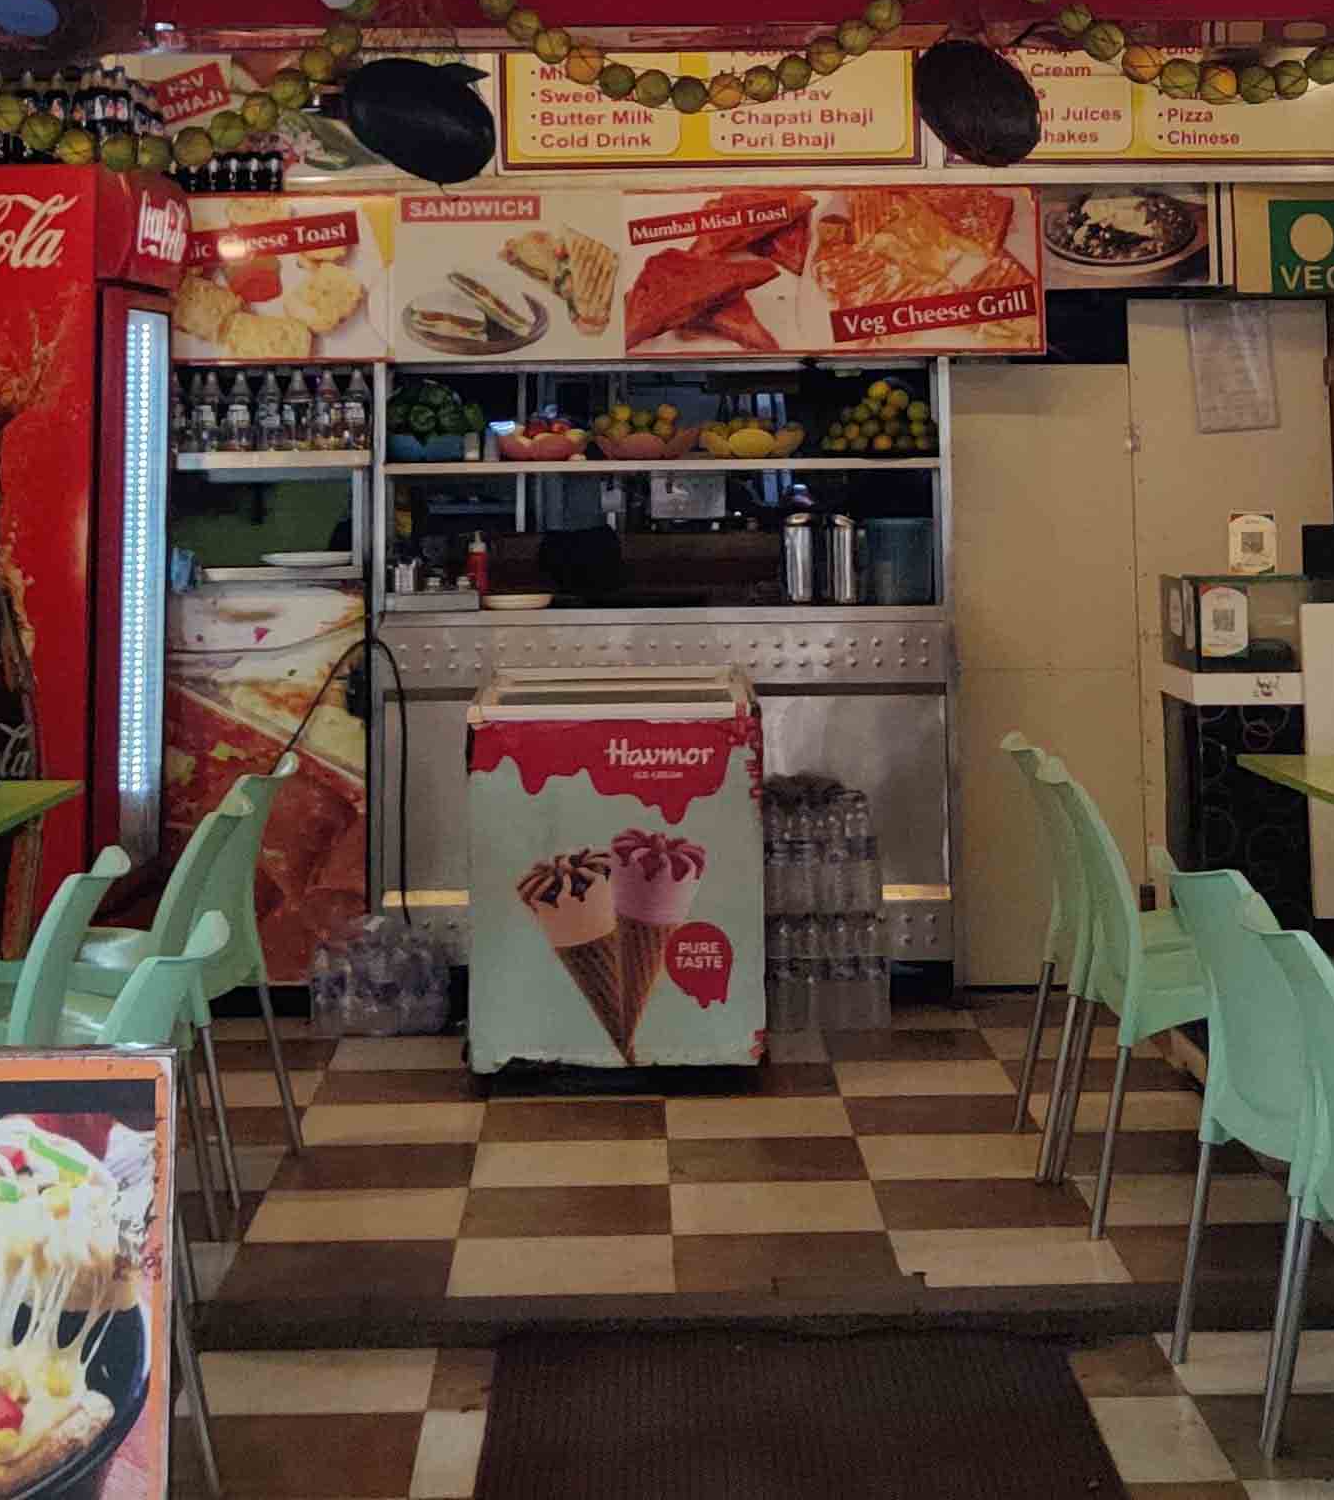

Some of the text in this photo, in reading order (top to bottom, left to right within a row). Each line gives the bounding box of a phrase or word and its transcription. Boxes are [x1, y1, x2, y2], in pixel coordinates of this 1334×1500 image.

[540, 111, 654, 126] Butter Milk
[730, 108, 873, 127] Chapati Bhaji
[1061, 108, 1122, 122] Juices
[1167, 108, 1213, 122] Pizza
[540, 133, 652, 148] Cold Drink
[732, 132, 835, 149] Puri Bhaji
[1040, 131, 1099, 144] hakes
[1167, 130, 1240, 145] Chinese
[410, 201, 534, 217] SANDWICH
[632, 206, 788, 242] Mumbai Misal Toast
[293, 222, 347, 244] Toast
[842, 290, 1028, 335] Veg Cheese Grill
[604, 738, 715, 766] Havmor
[678, 941, 723, 954] PURE
[675, 955, 724, 969] TASTE
